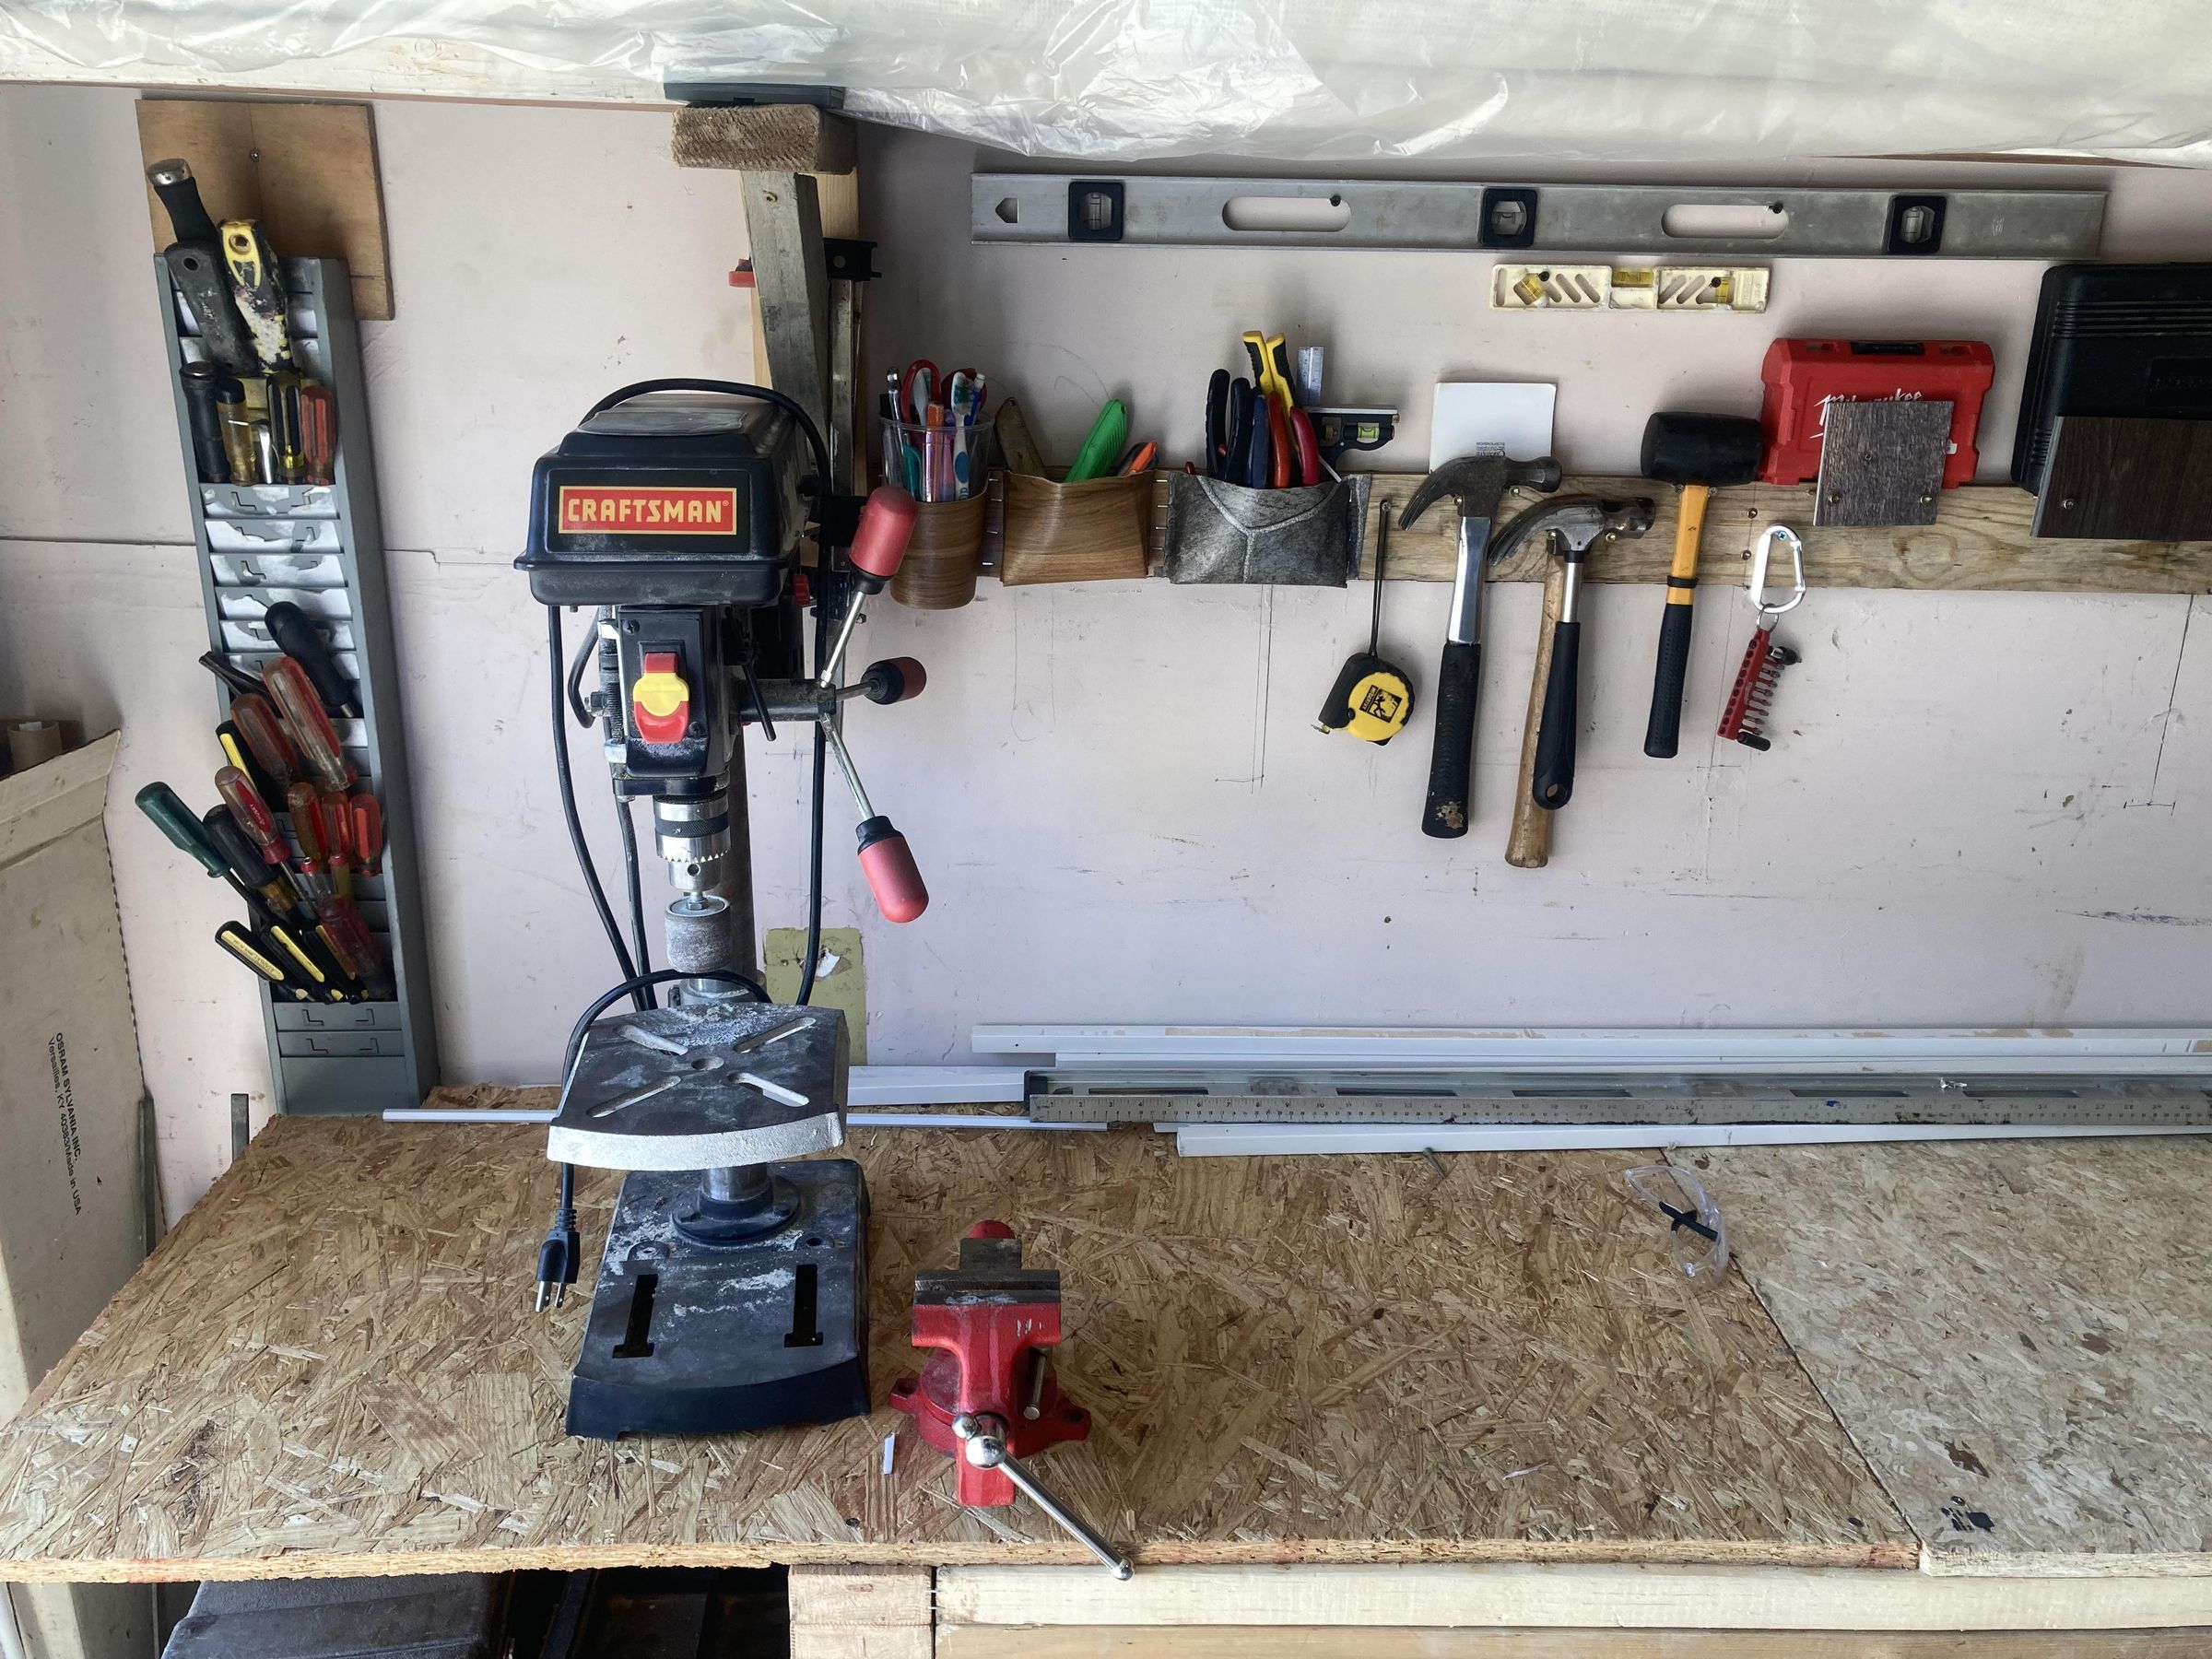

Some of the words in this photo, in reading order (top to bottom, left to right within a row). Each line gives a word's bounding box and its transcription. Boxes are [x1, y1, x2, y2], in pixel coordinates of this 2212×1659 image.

[568, 499, 722, 524] CRAFTSMAN
[48, 1036, 60, 1093] Versailles,
[56, 1032, 68, 1077] OSRAM
[63, 1078, 77, 1135] SYLVANIA
[72, 1136, 81, 1161] INC.
[57, 1093, 65, 1109] KY
[70, 1177, 76, 1189] in
[72, 1189, 82, 1216] USA
